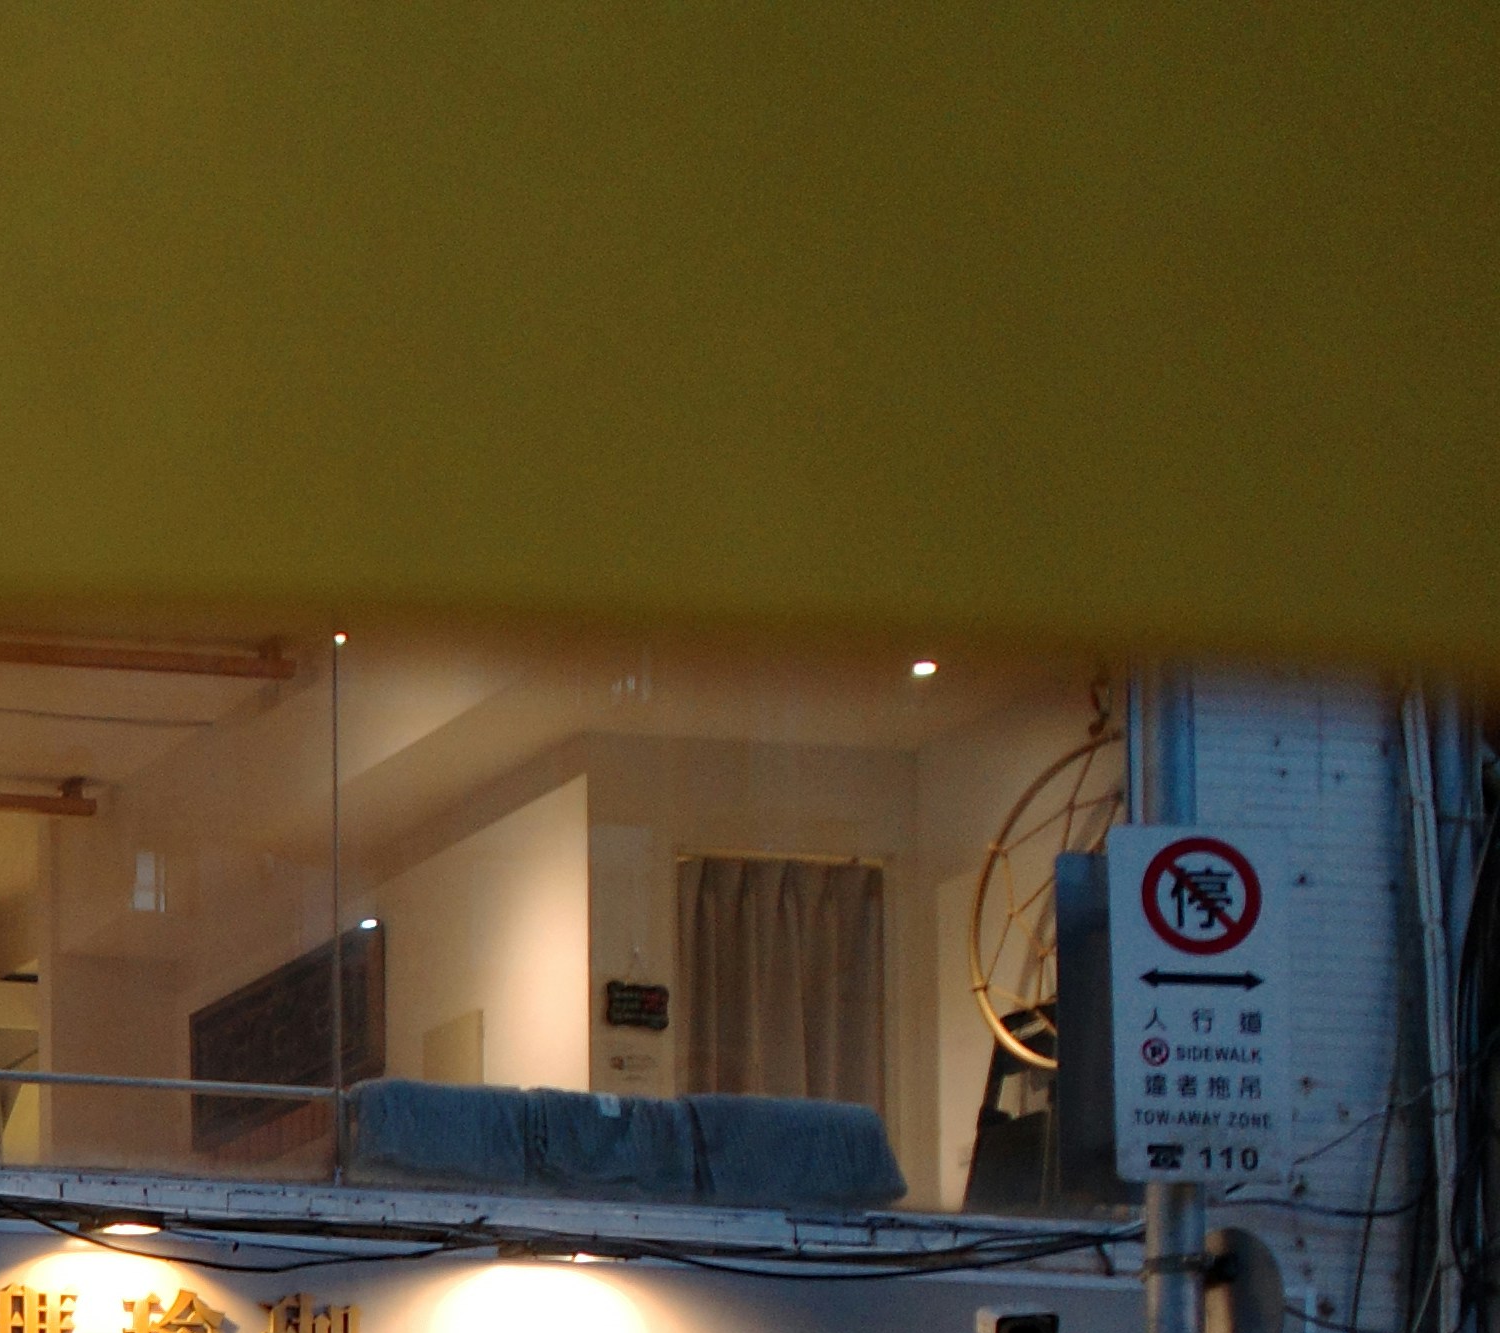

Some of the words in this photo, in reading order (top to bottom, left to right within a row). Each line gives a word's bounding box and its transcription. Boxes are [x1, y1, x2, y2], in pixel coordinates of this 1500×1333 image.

[1171, 866, 1233, 929] 停
[1143, 1007, 1262, 1035] 人行道
[1176, 1047, 1262, 1063] SIDEWALK
[1145, 1074, 1262, 1099] 違者拖吊
[1228, 1111, 1271, 1129] ZONE
[1199, 1146, 1259, 1170] 110
